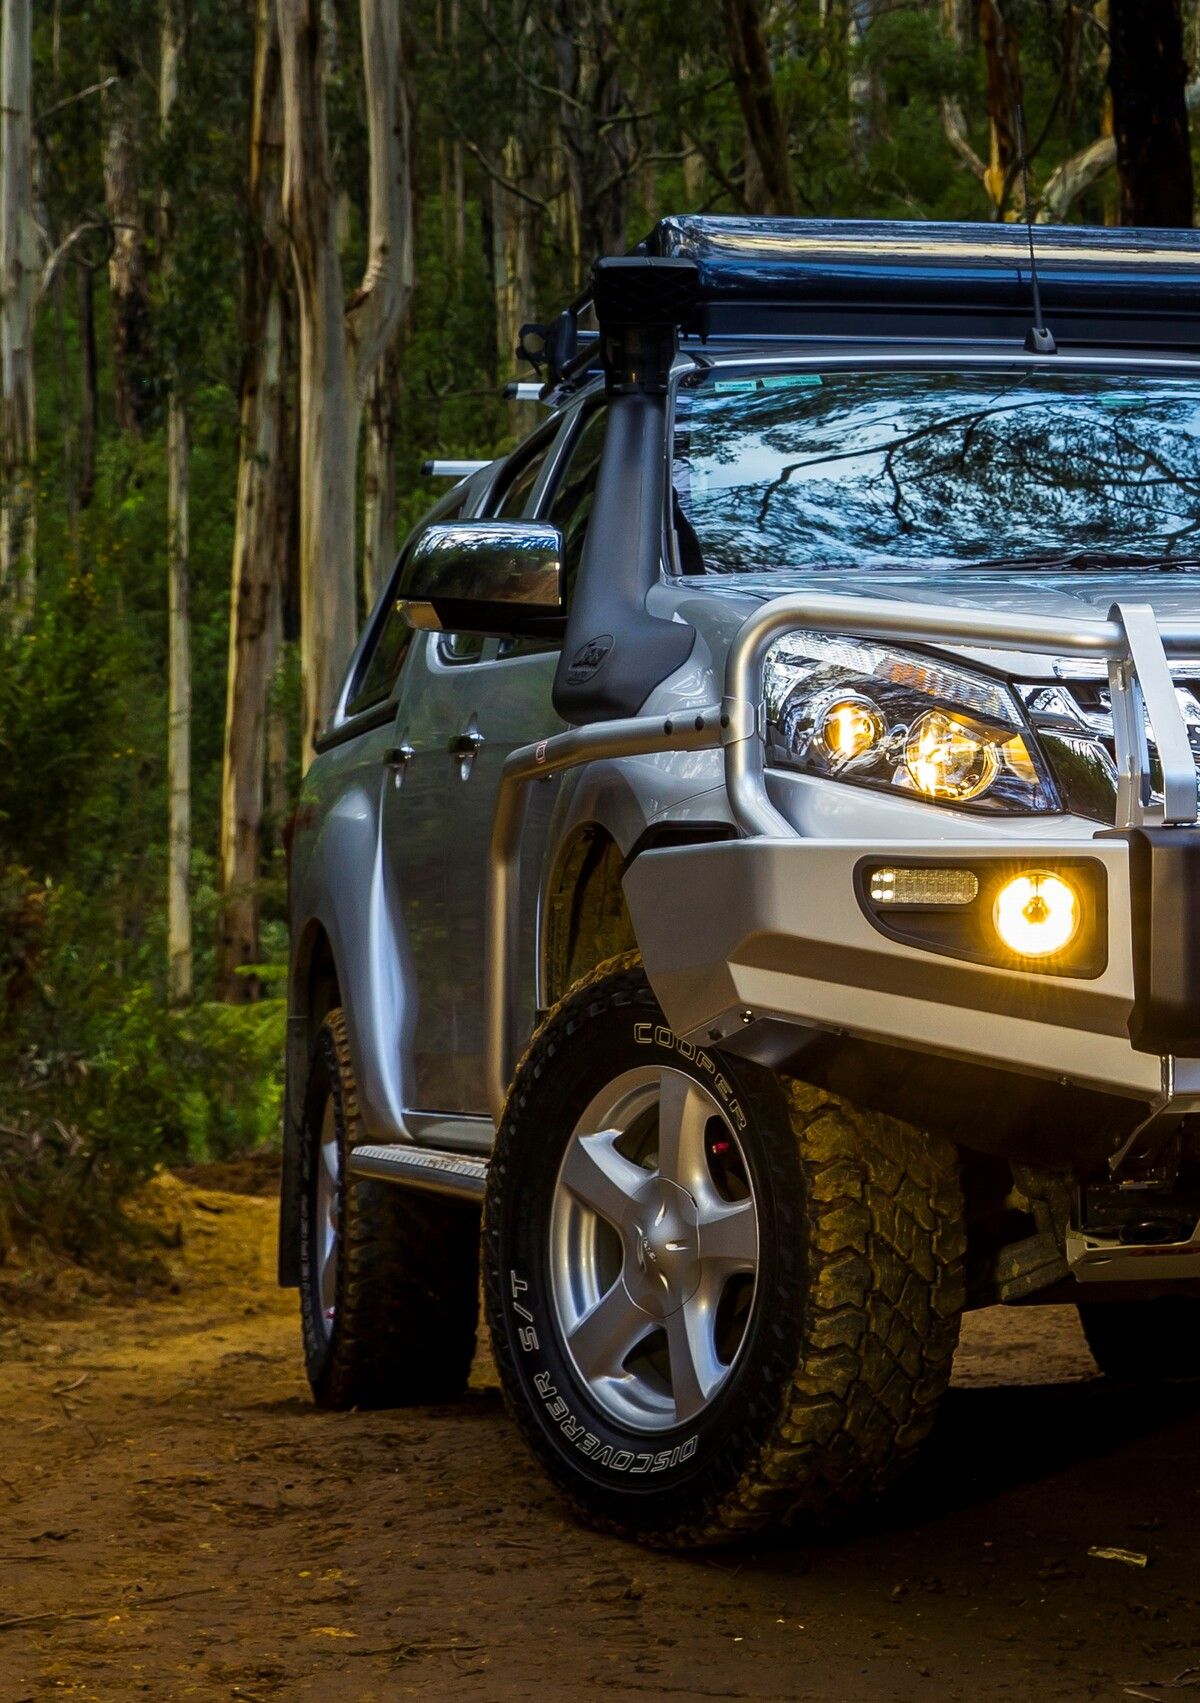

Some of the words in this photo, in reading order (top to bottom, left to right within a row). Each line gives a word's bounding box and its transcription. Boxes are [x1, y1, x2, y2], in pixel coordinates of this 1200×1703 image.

[633, 1022, 748, 1132] COOPER
[509, 1269, 541, 1353] S/T
[533, 1371, 700, 1474] DISCOVERER
